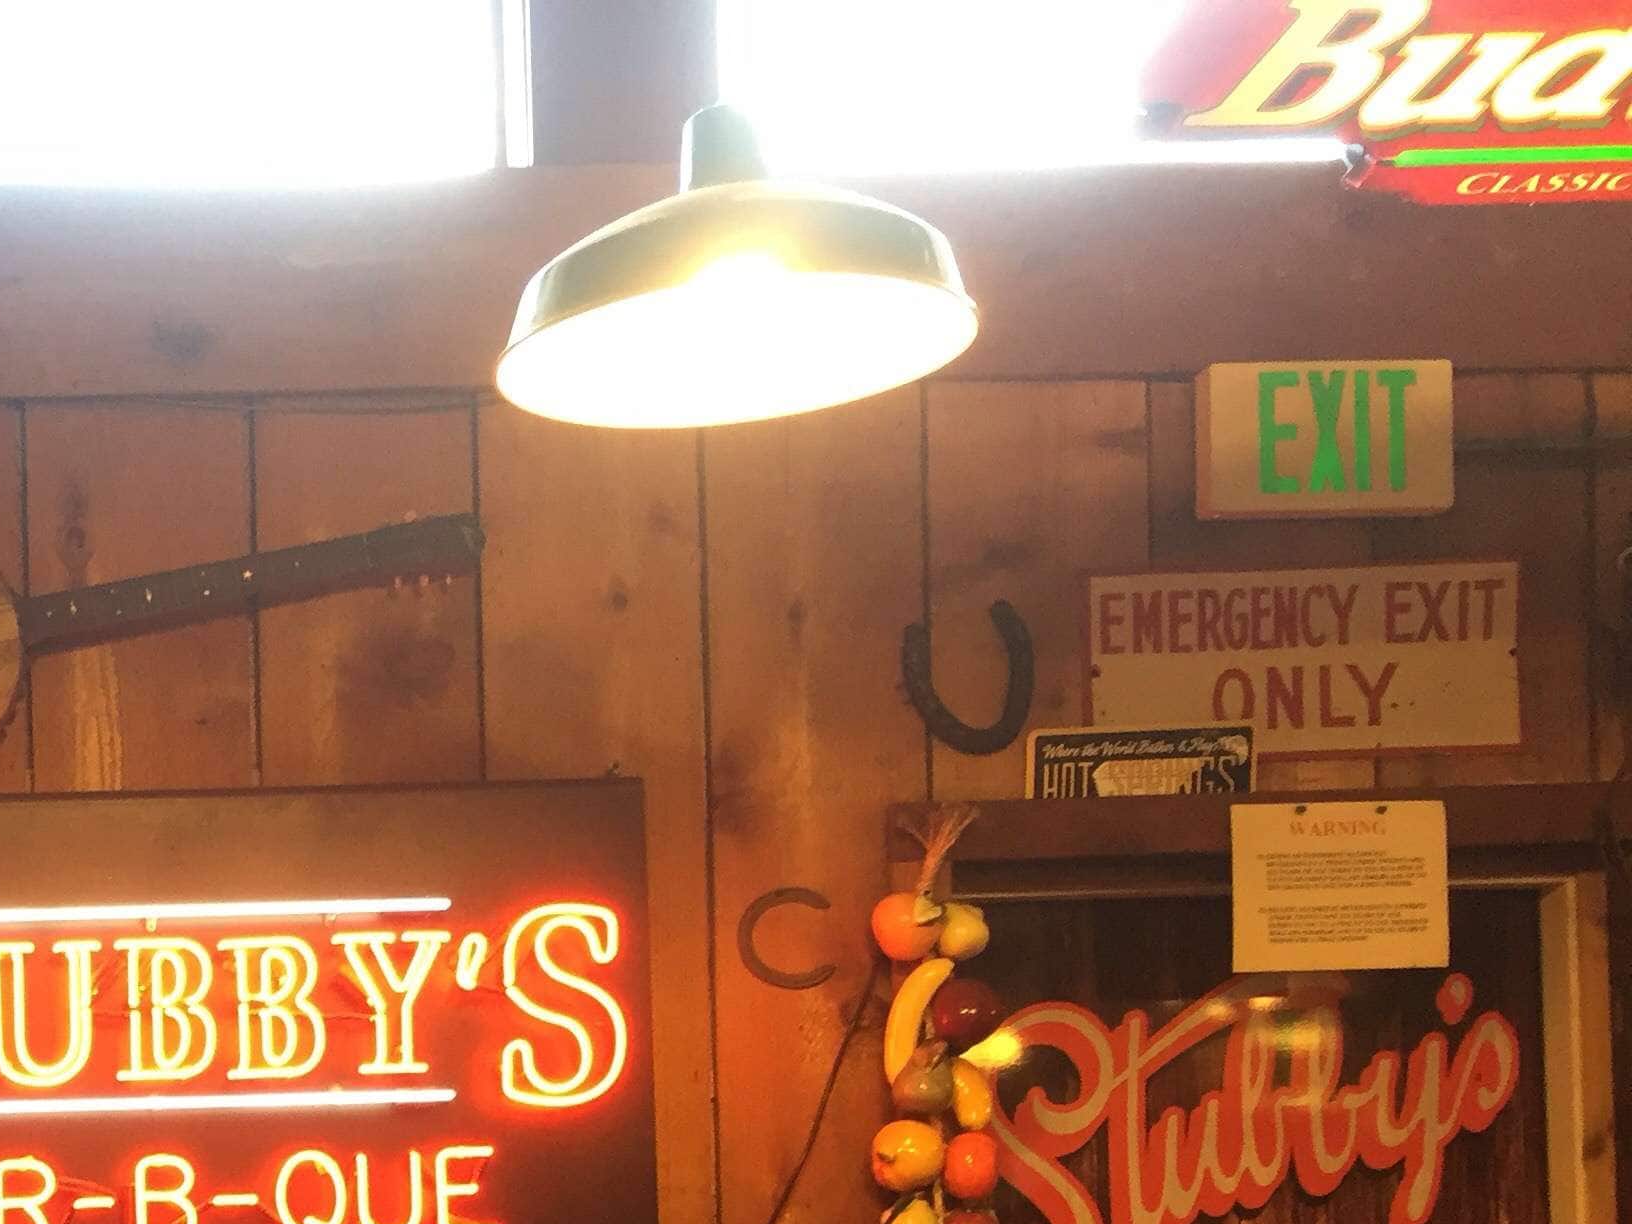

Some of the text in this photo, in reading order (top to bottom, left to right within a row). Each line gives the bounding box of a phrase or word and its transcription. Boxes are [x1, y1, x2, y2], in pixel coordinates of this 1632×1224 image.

[1455, 171, 1632, 196] CLASSIC
[1257, 369, 1416, 494] EXIT
[1099, 579, 1505, 655] EMERGENCY EXIT
[1212, 662, 1399, 729] ONLY
[1043, 761, 1094, 800] HOT
[1289, 820, 1387, 836] WARNING
